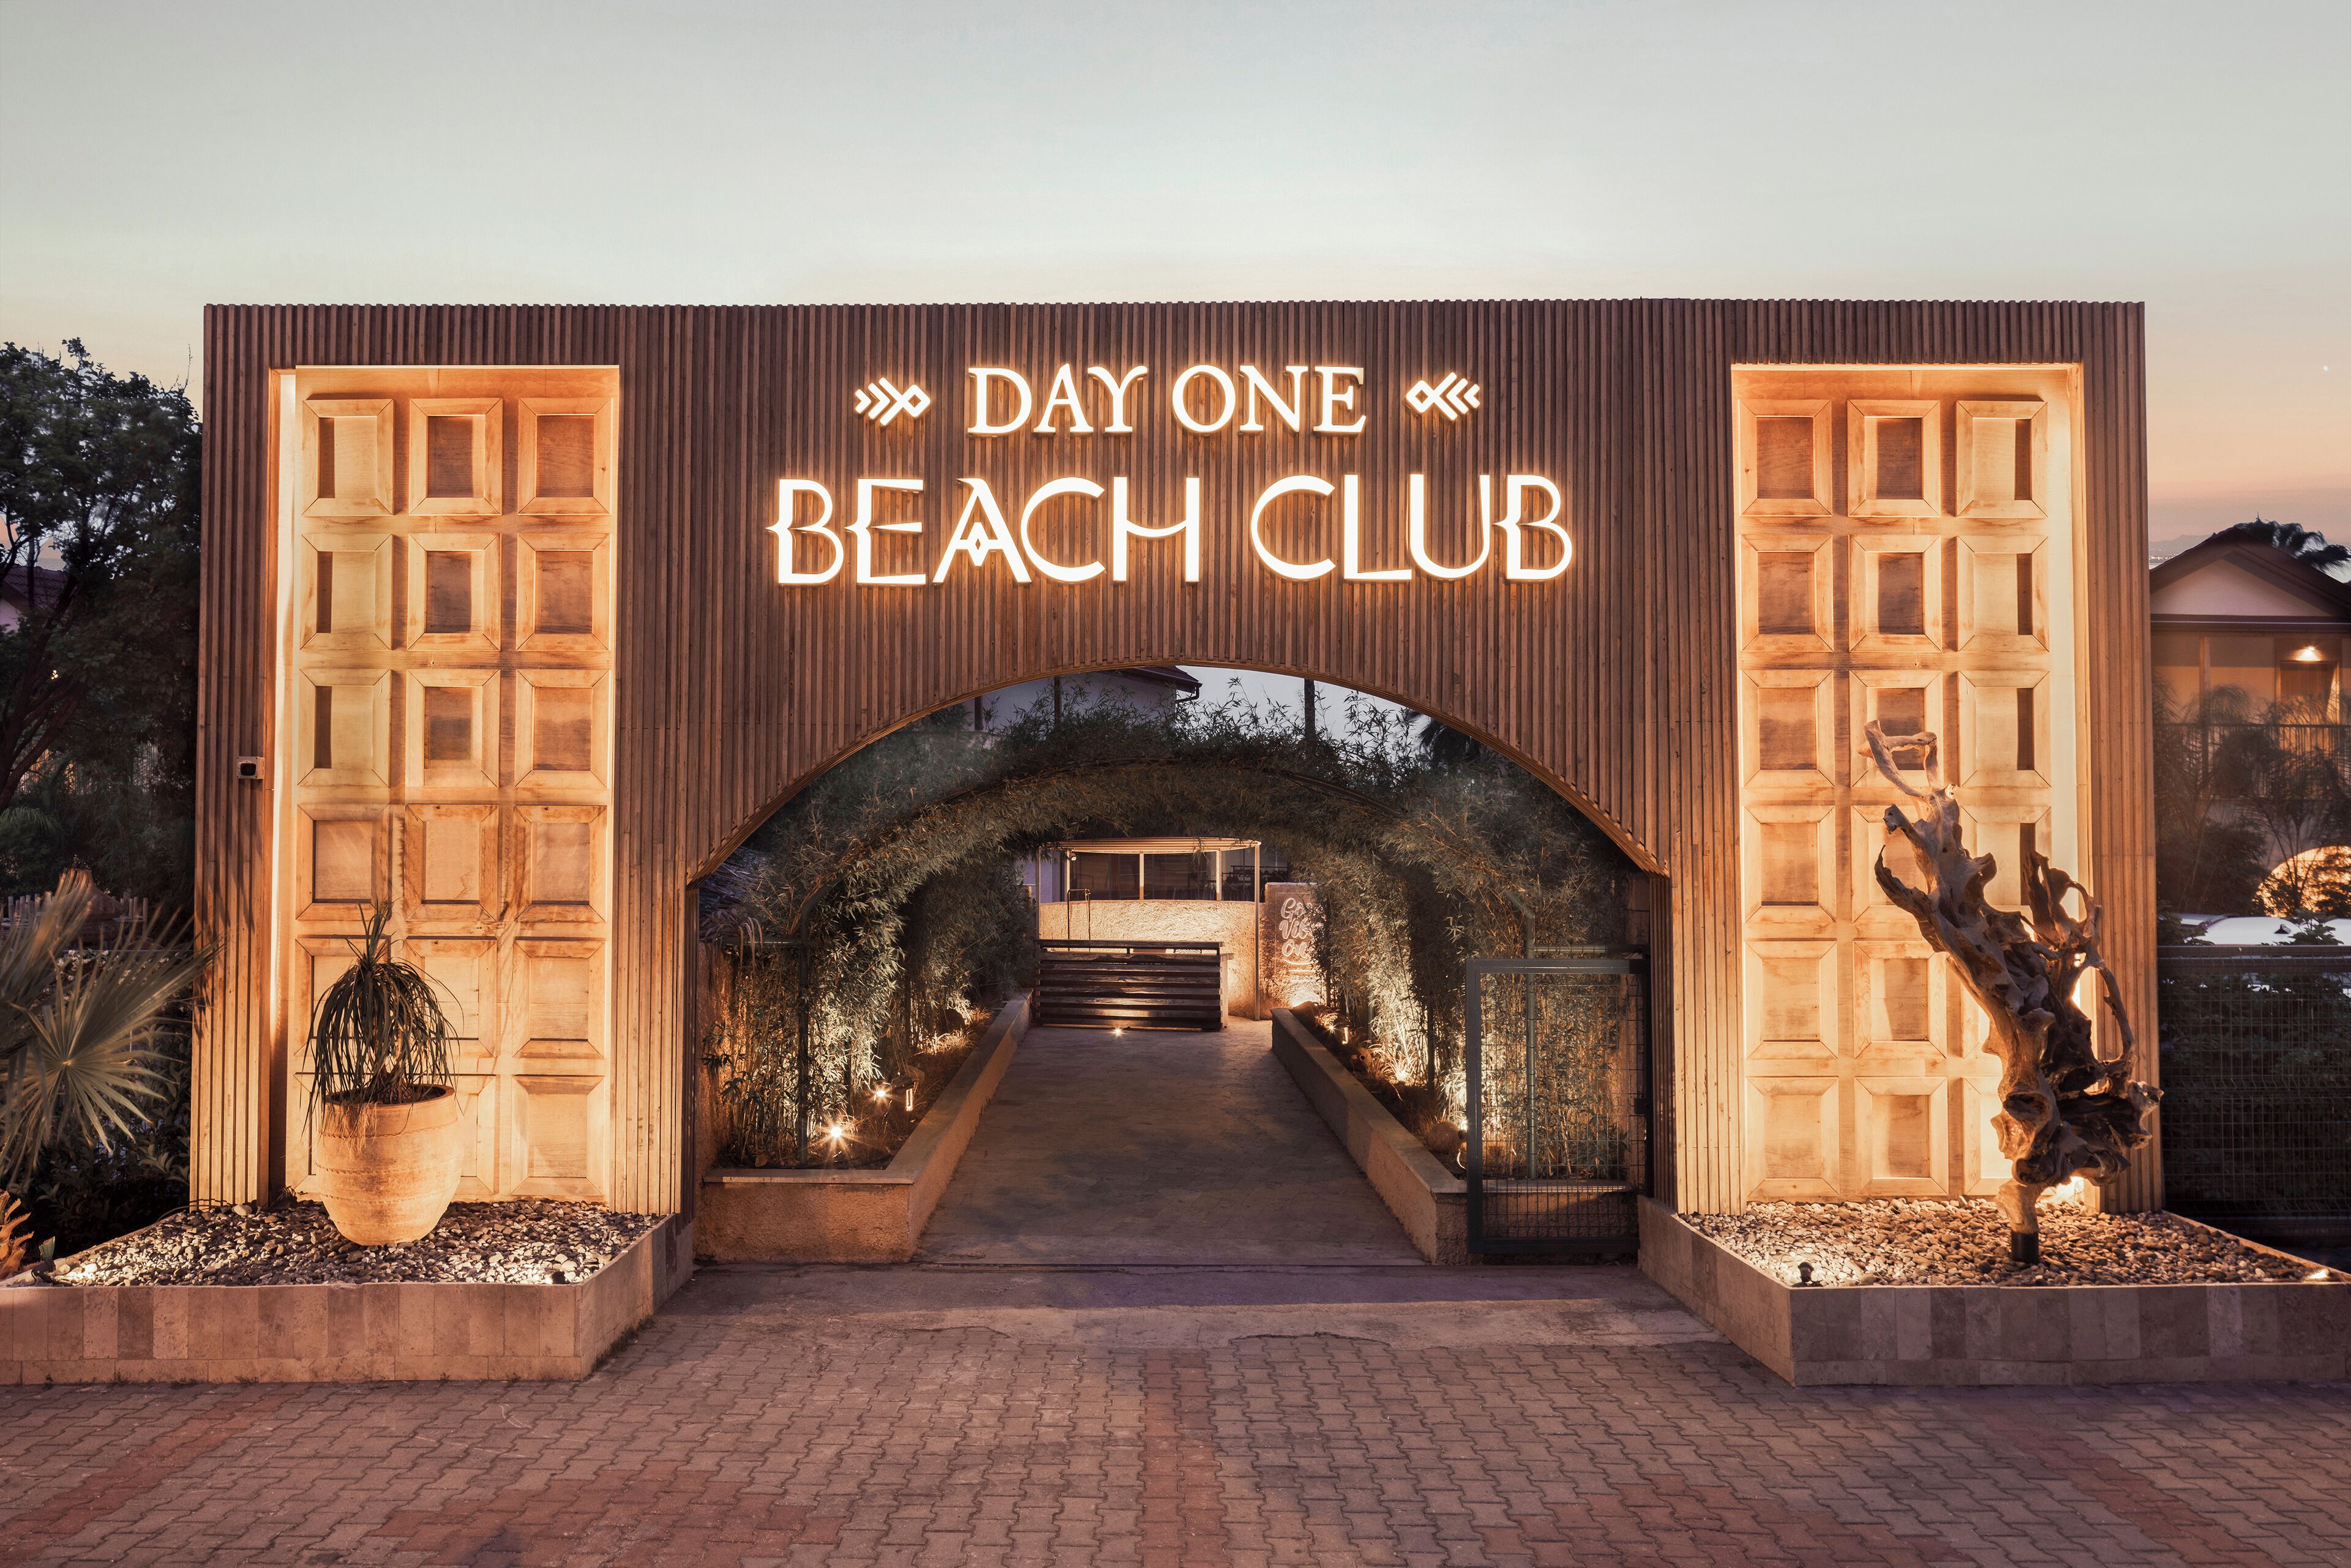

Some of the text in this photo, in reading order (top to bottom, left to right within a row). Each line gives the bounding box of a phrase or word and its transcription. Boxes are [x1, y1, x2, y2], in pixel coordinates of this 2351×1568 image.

[967, 363, 1367, 434] DAY ONE
[766, 474, 1573, 585] BEACH CLUB
[1279, 917, 1323, 939] Vib
[1281, 898, 1325, 922] Go
